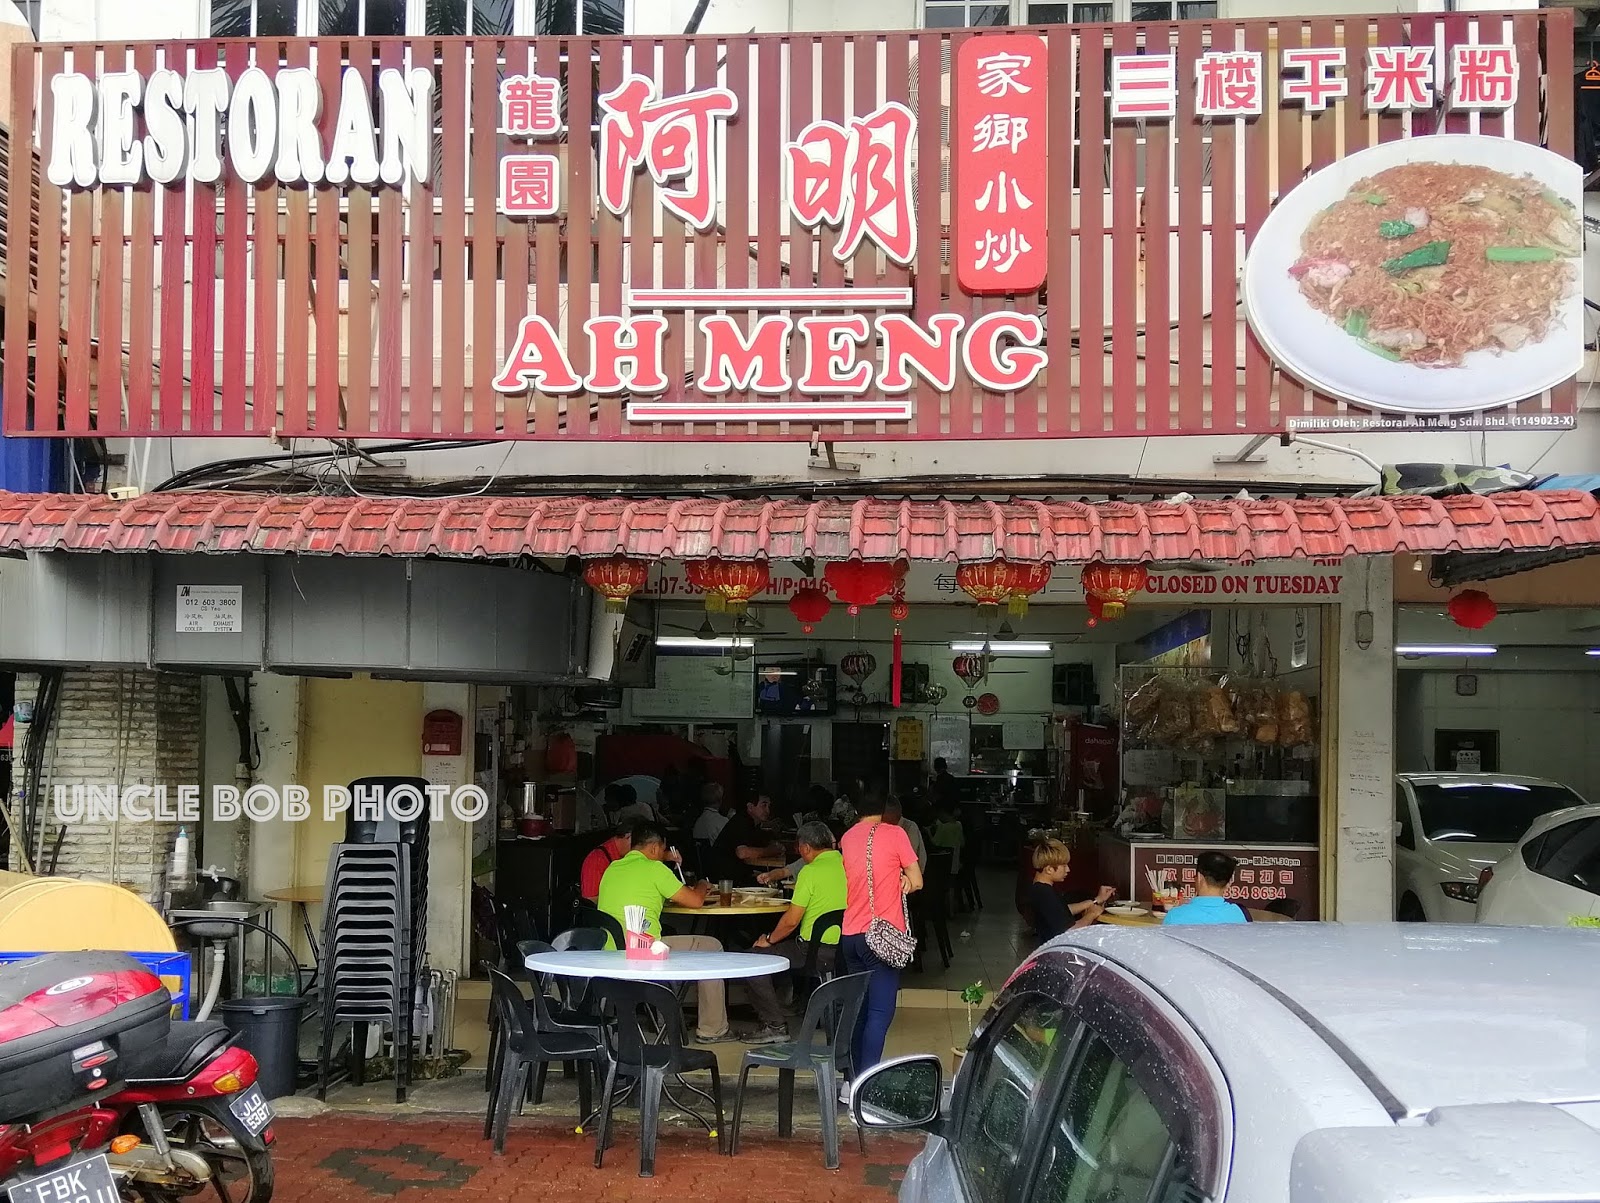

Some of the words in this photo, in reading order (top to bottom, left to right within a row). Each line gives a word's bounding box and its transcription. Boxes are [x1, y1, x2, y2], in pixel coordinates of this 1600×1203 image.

[1112, 45, 1521, 118] 三楼干米粉
[47, 66, 434, 187] RESTORAN
[500, 76, 561, 217] 龍園
[972, 51, 1033, 274] 家鄉小炒
[598, 74, 918, 264] 阿明
[493, 313, 670, 394] AH
[697, 311, 1050, 394] MENG
[1289, 418, 1330, 428] Dimiliki
[1332, 418, 1360, 428] Oleh:
[1363, 418, 1408, 428] Restoran
[1411, 418, 1425, 427] Ah
[1428, 418, 1457, 429] Meng
[1459, 417, 1483, 427] Sdn.
[1485, 416, 1509, 426] Bhd.
[1511, 415, 1575, 427] (1149023-X)
[1145, 575, 1217, 594] CLOSED
[1221, 575, 1249, 593] ON
[1253, 575, 1343, 594] TUESDAY
[36, 1168, 87, 1203] FBK
